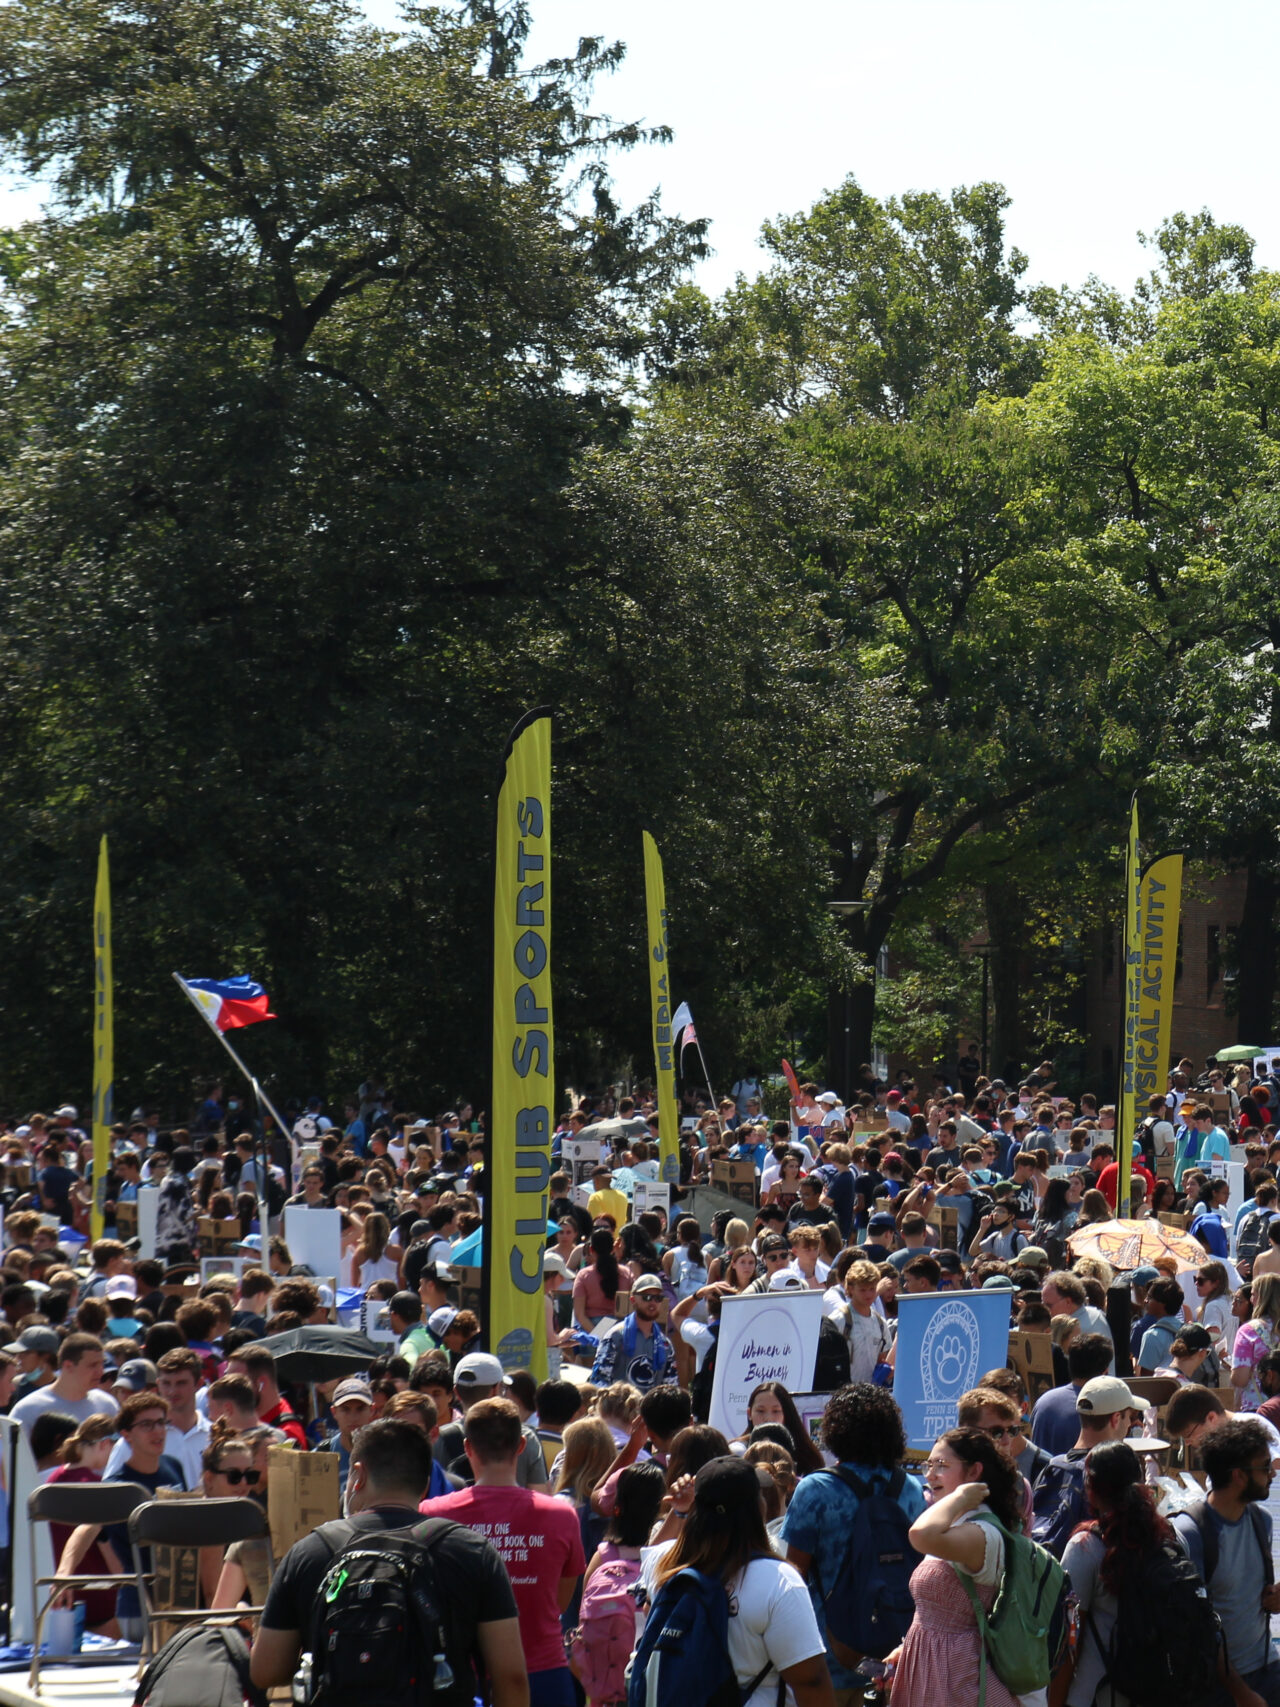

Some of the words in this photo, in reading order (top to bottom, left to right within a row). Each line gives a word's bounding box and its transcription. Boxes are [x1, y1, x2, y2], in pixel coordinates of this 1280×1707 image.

[512, 797, 549, 1078] SPORTS
[1143, 877, 1167, 1001] ACTIVITY
[656, 974, 672, 1070] MEDIA
[1134, 1010, 1160, 1130] HYSICAL
[510, 1105, 550, 1294] CLUB
[741, 1339, 781, 1360] Women
[782, 1344, 792, 1356] in
[743, 1362, 789, 1382] Business
[926, 1405, 946, 1415] PENN
[494, 1523, 510, 1534] ONE
[528, 1535, 545, 1547] ONE
[514, 1549, 529, 1561] THE
